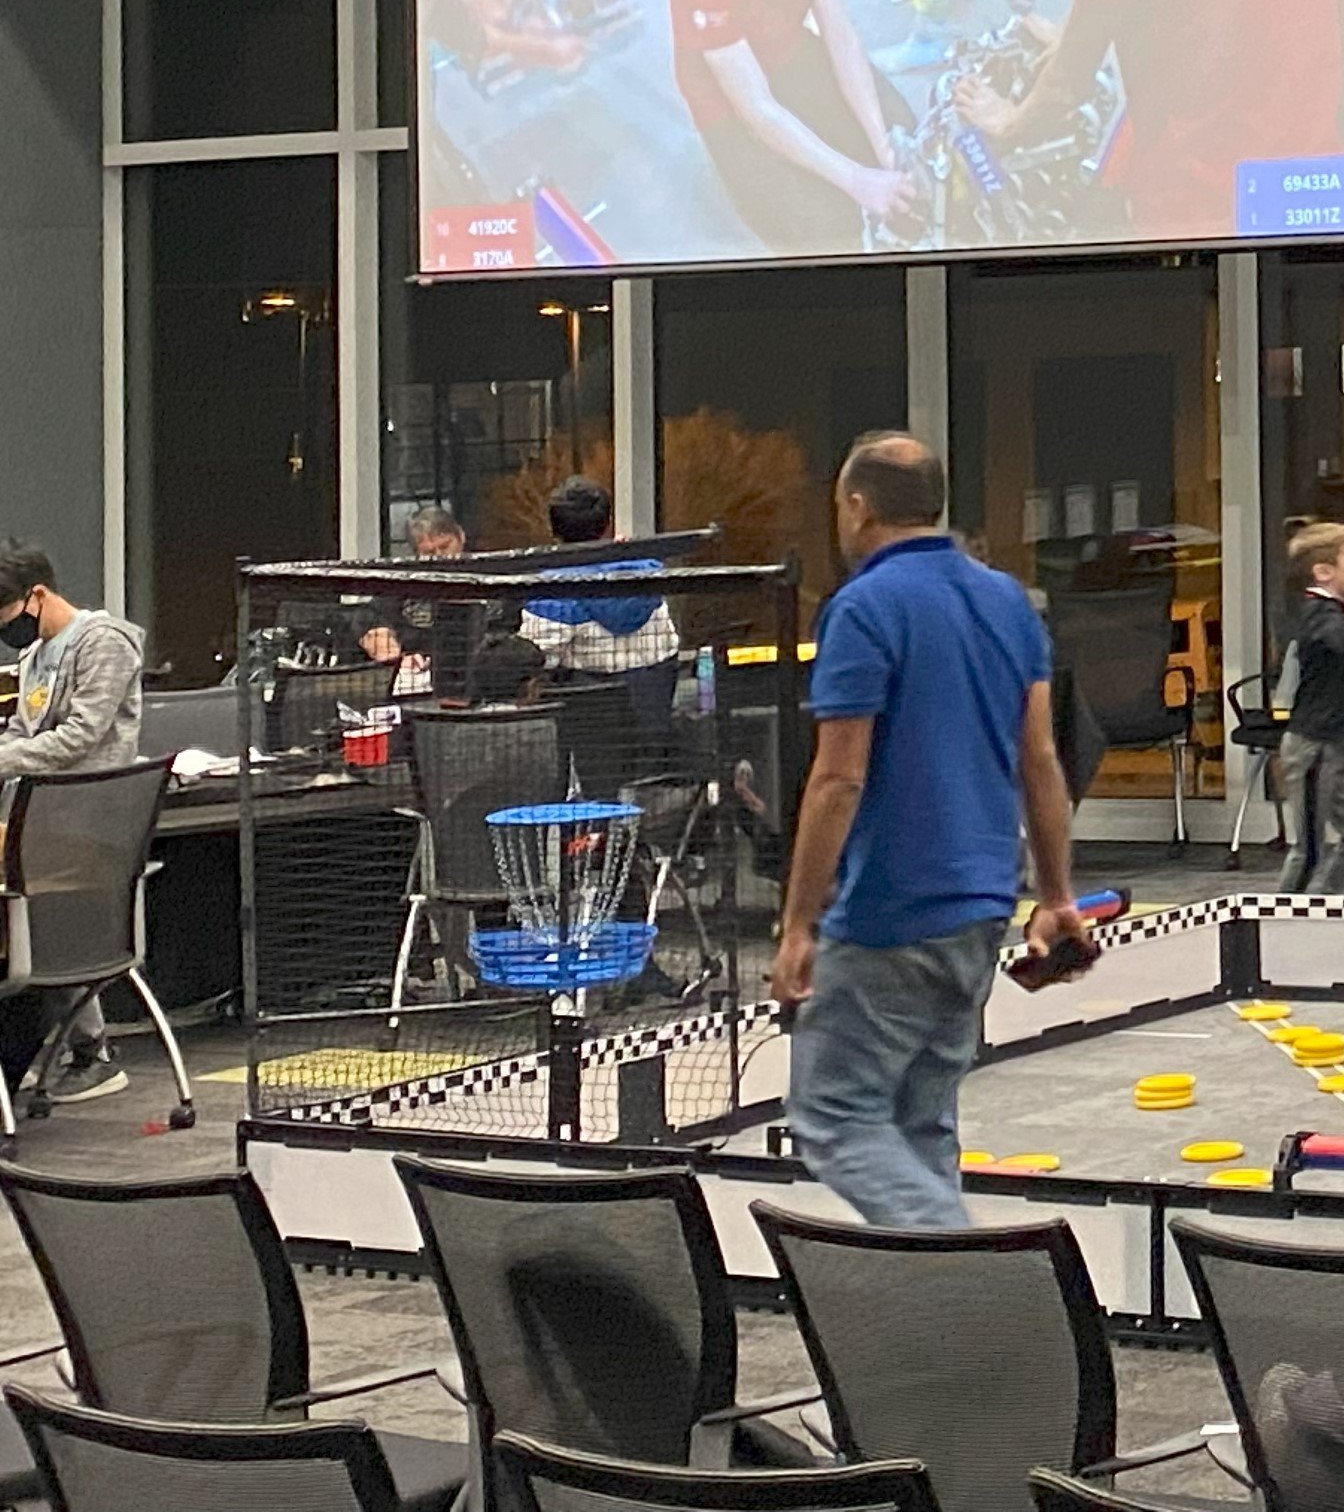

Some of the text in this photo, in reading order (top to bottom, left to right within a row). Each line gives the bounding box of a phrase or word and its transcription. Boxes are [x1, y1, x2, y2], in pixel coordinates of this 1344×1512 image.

[1283, 173, 1341, 192] 69433A
[1285, 207, 1340, 226] 33011Z
[468, 219, 517, 236] 41920C
